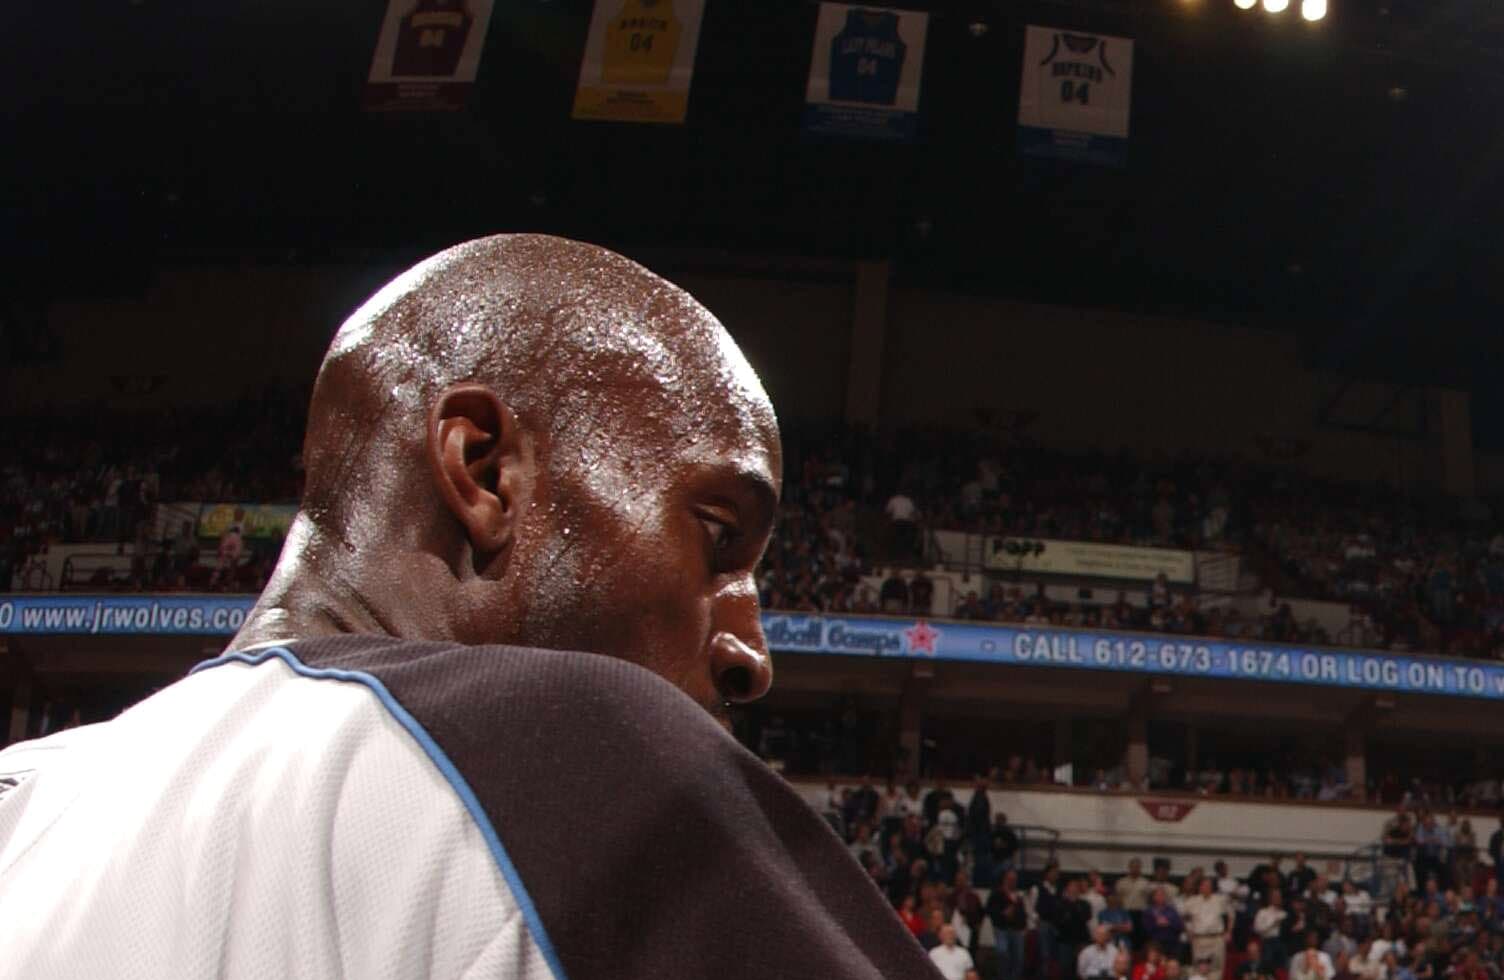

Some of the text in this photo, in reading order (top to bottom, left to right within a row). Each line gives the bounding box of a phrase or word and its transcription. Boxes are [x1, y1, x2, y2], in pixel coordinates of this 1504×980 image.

[1061, 80, 1090, 105] 04
[23, 602, 251, 635] www.jrwolves.co
[766, 619, 823, 648] tball
[1014, 632, 1083, 663] CALL
[1094, 637, 1291, 675] 612-673-1674
[1302, 653, 1339, 680] OR
[1347, 656, 1399, 686] LOG
[1408, 662, 1444, 689] ON
[1453, 669, 1485, 693] TO
